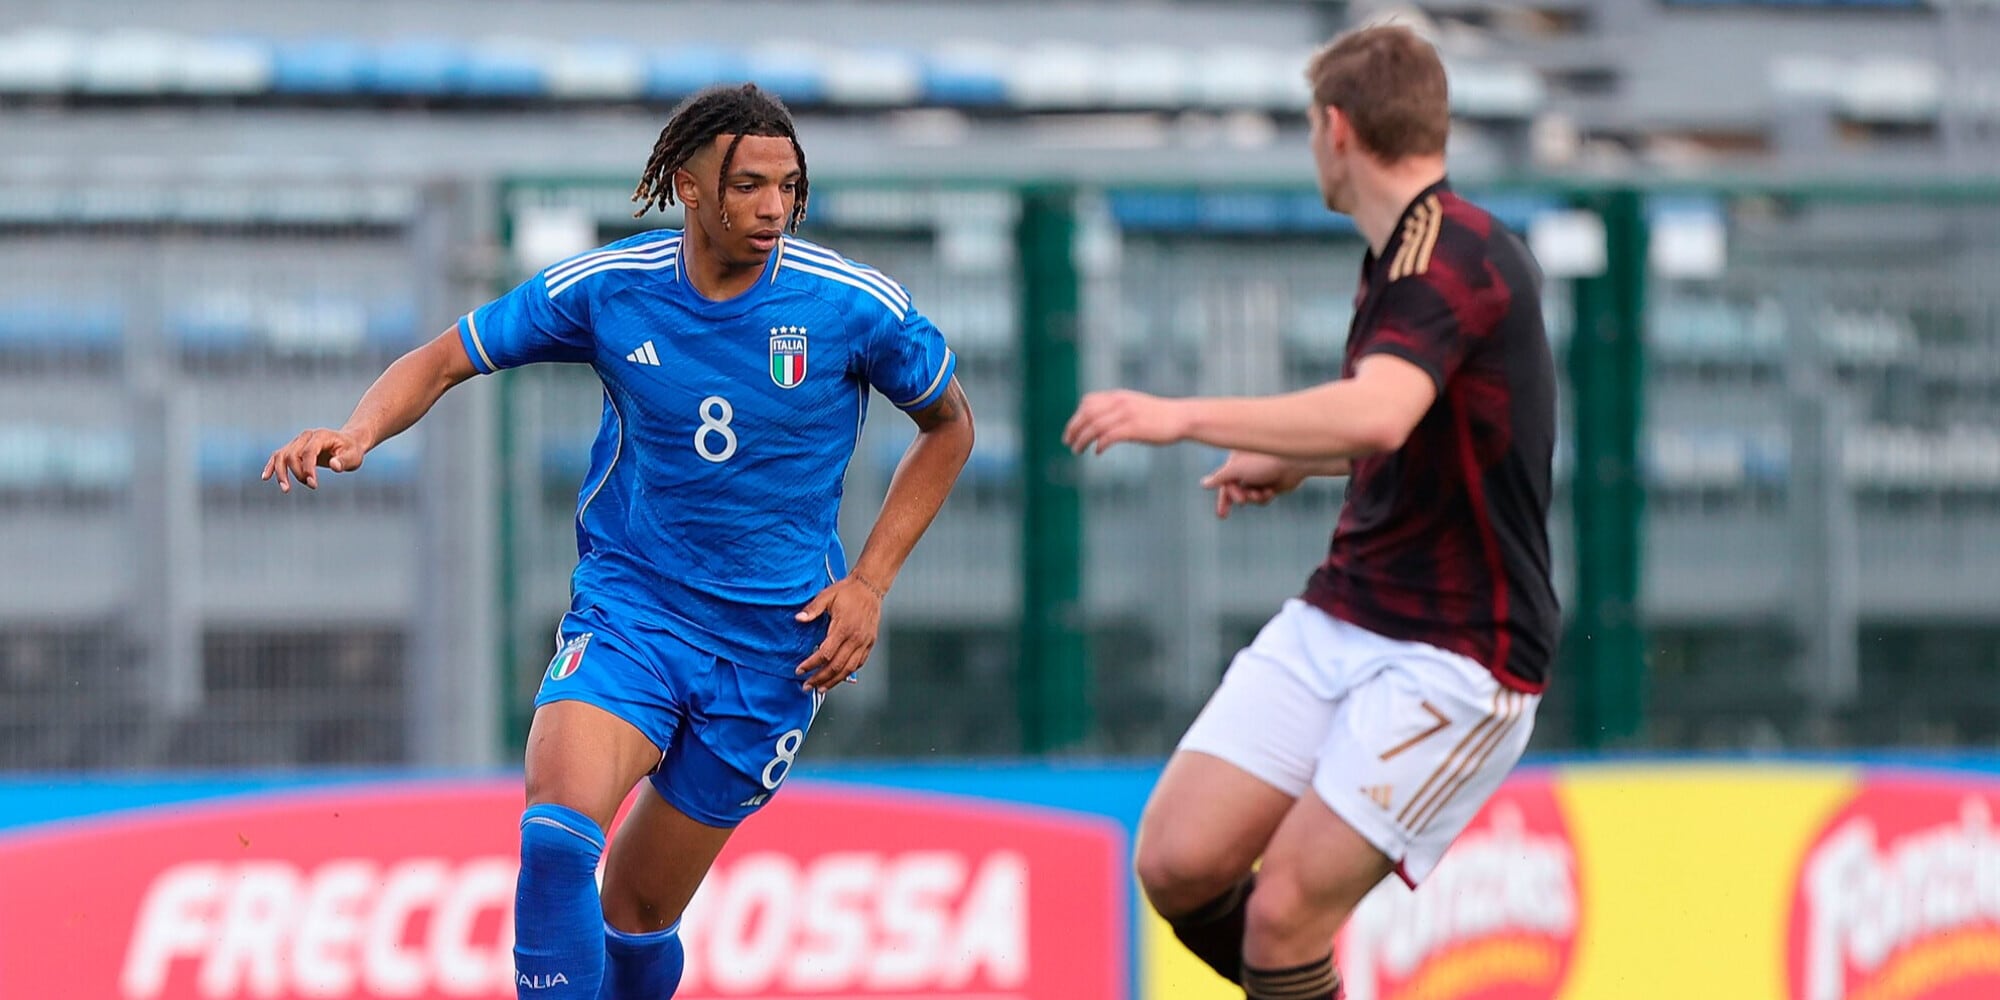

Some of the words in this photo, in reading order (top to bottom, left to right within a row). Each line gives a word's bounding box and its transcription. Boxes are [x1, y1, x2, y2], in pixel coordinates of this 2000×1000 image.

[773, 339, 804, 350] ITALIA
[694, 395, 738, 463] 8
[761, 728, 804, 791] 8
[1378, 700, 1452, 762] 7
[120, 852, 1030, 998] FRECCOSSA
[515, 968, 569, 989] TALIA
